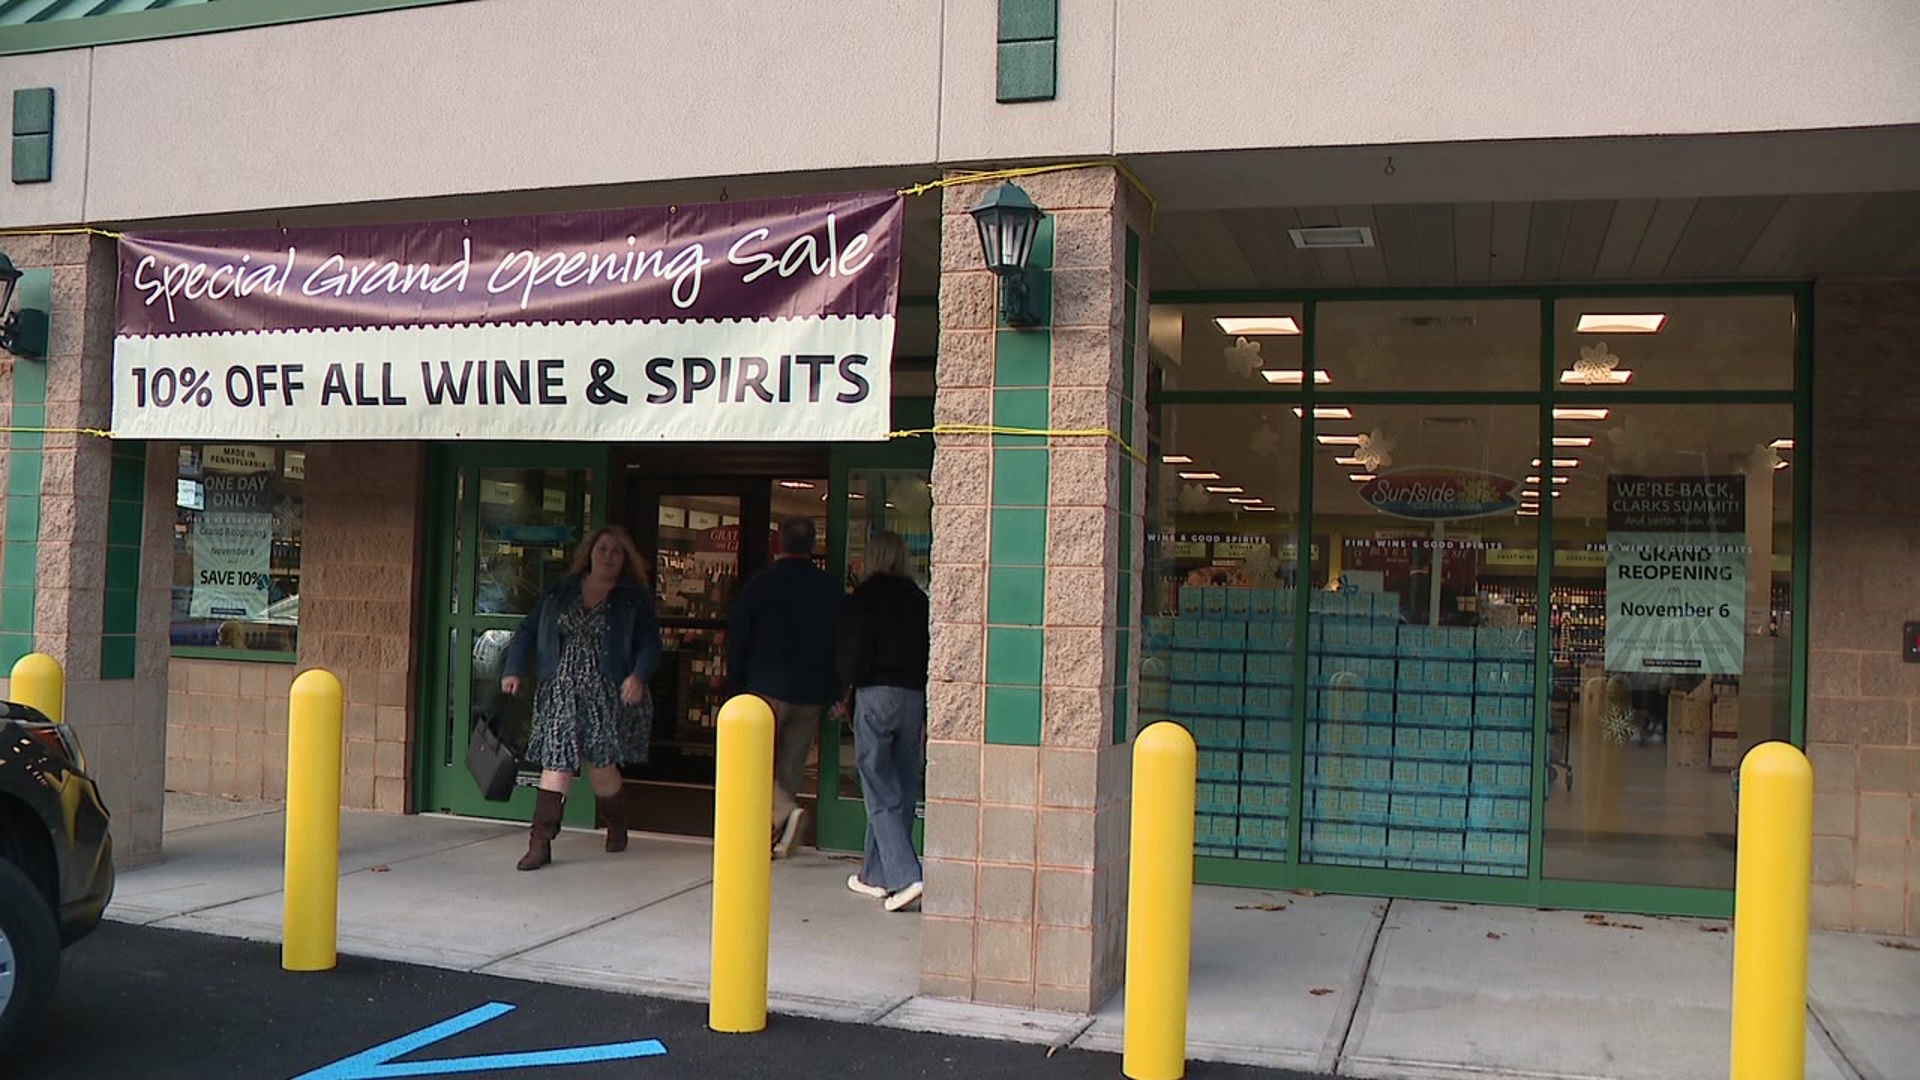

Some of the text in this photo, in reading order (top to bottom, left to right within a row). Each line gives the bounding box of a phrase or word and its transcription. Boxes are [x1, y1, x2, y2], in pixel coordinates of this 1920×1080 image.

[134, 214, 876, 321] Special Grand Opening Sale
[131, 353, 870, 408] 10% OFF ALL WINE & SPIRITS
[223, 447, 256, 459] MADE IN
[210, 455, 266, 468] PENNSYLVANIA
[203, 475, 267, 491] ONE DAY
[1616, 482, 1734, 499] WE'RE BACK,
[212, 492, 257, 507] ONLY!
[1371, 479, 1456, 505] Surfside
[1612, 500, 1740, 513] CLARKS SUMMIT!
[1147, 534, 1175, 542] WINE
[1225, 535, 1266, 544] SPIRITS
[1344, 539, 1370, 547] FINE
[1376, 540, 1406, 548] WINE
[1423, 541, 1454, 549] GOOD
[1459, 541, 1503, 550] SPIRITS
[1586, 543, 1614, 552] FINE
[1619, 543, 1654, 552] WINE
[1669, 544, 1702, 553] GOOD
[1707, 545, 1753, 554] SPIRITS
[1639, 548, 1712, 563] GRAND
[200, 569, 235, 586] SAVE
[1618, 565, 1732, 581] REOPENING
[1620, 602, 1730, 618] November 6
